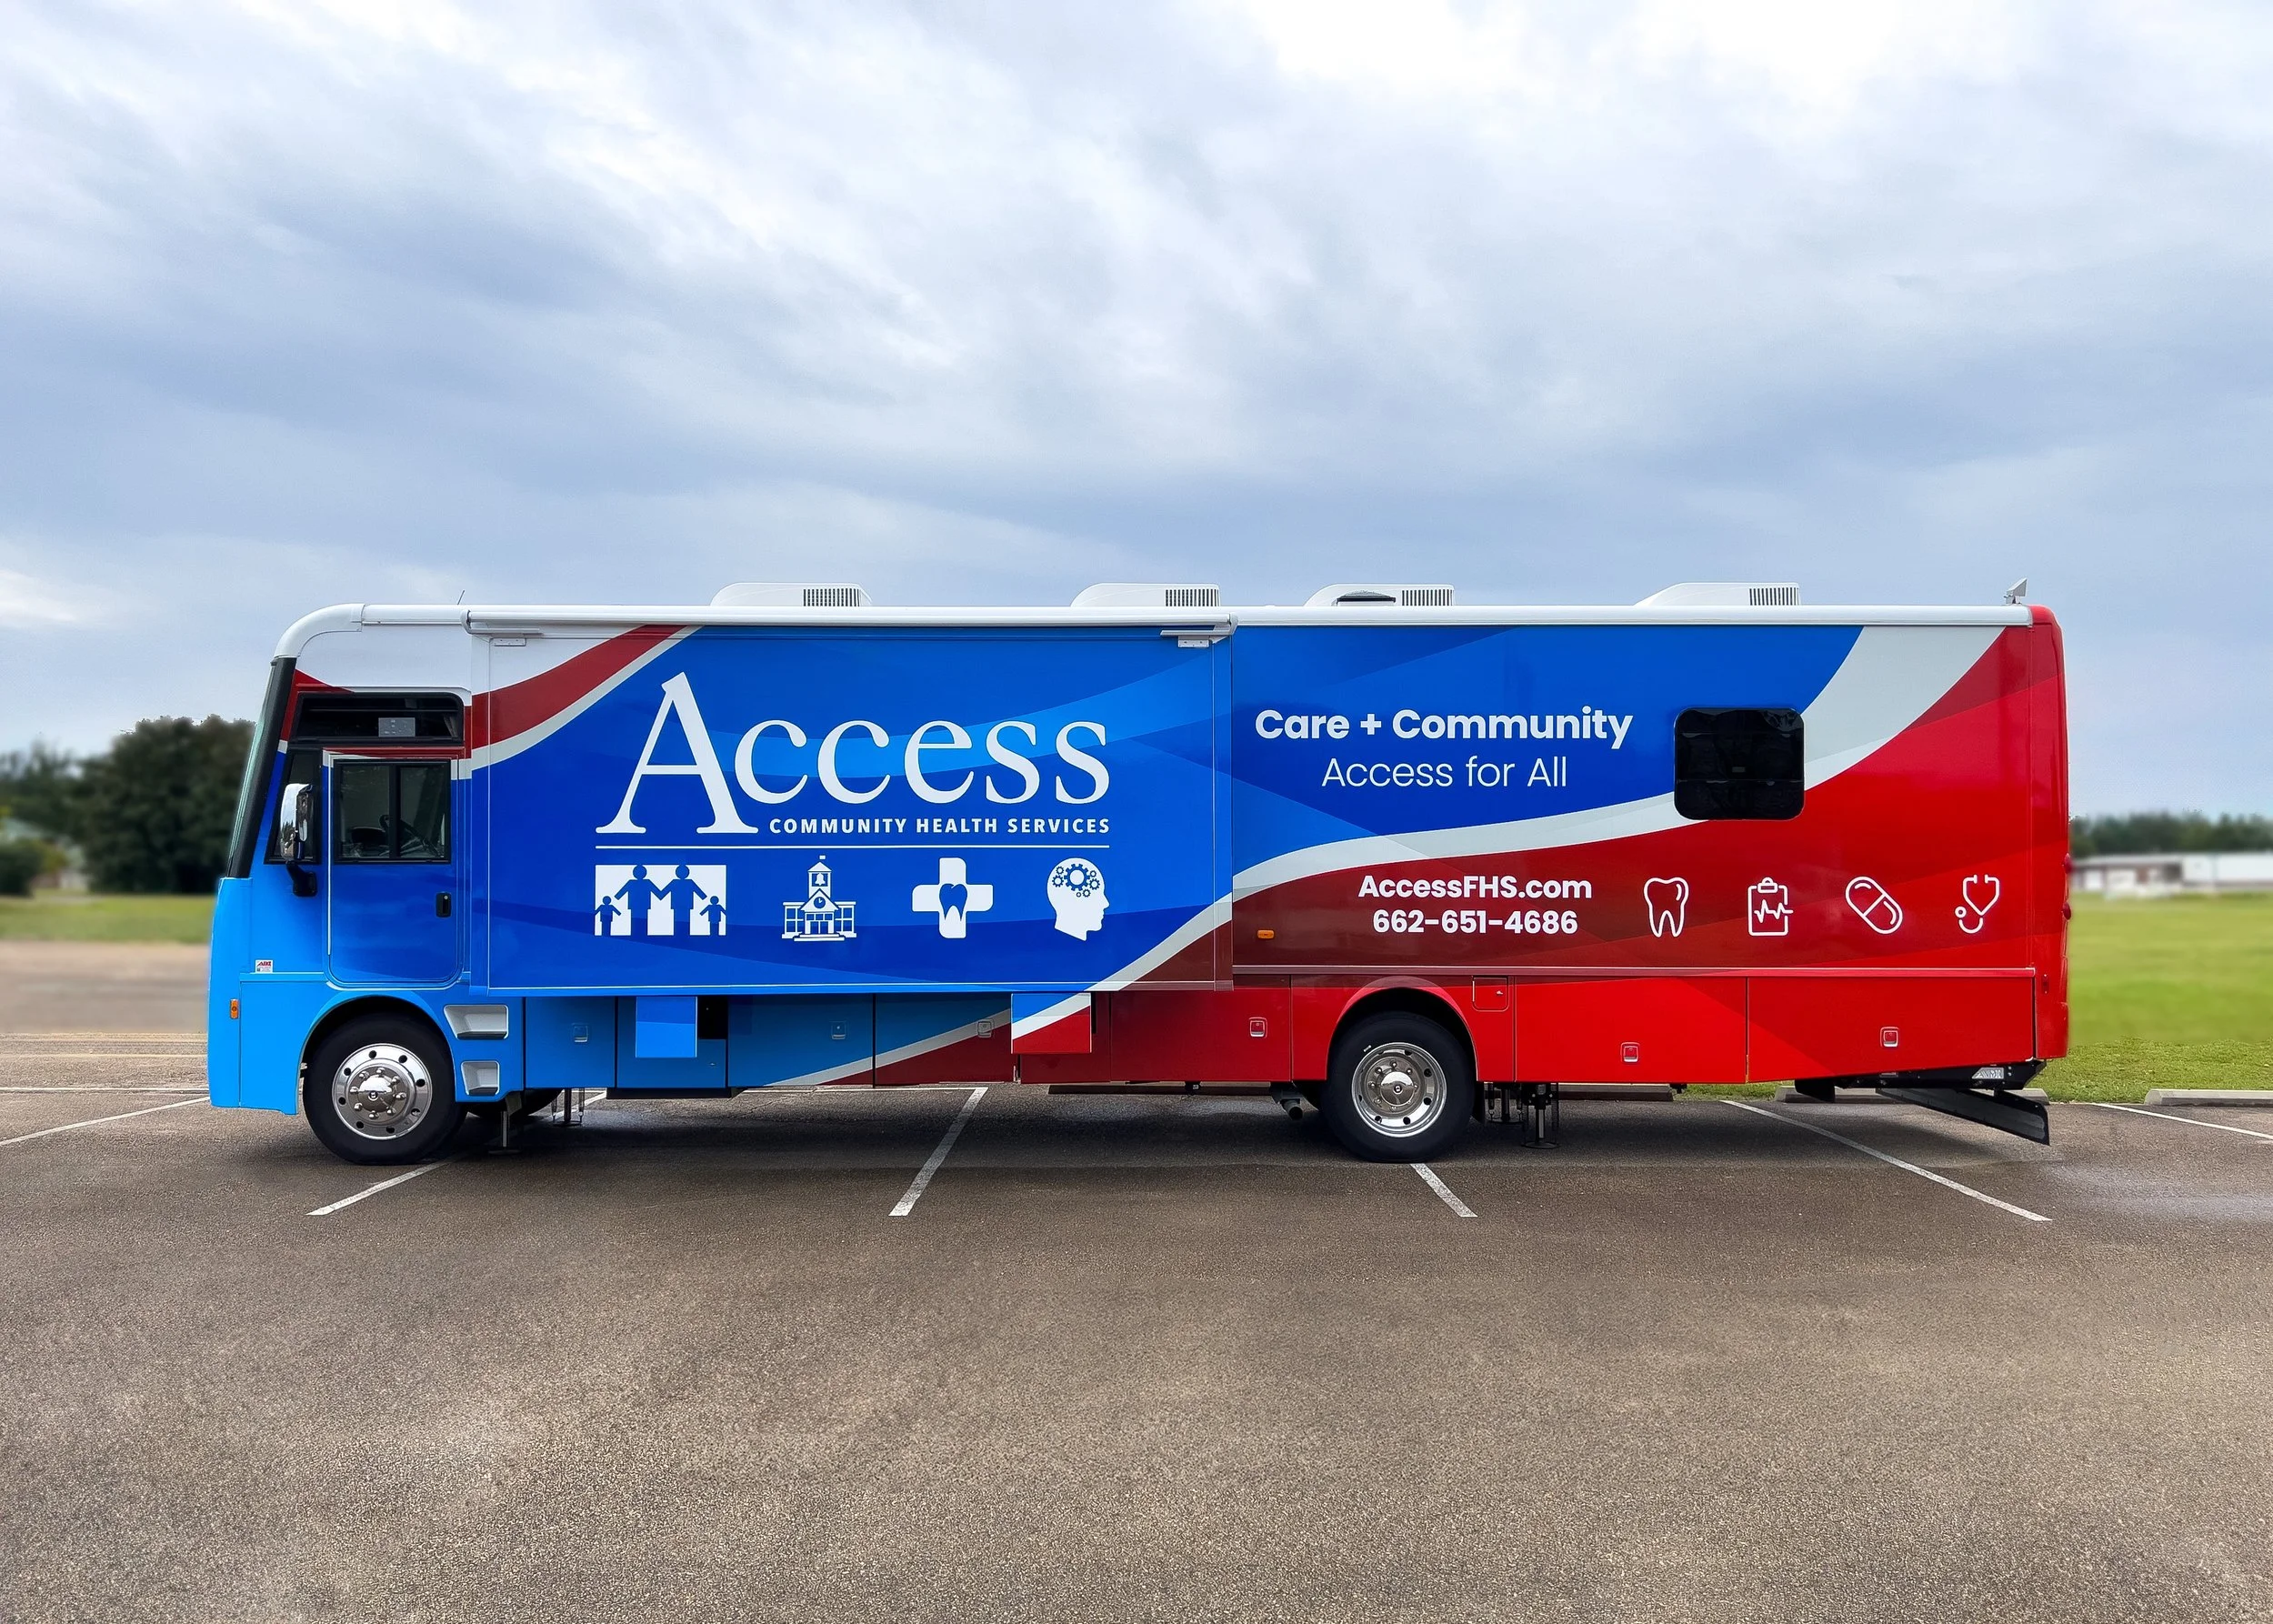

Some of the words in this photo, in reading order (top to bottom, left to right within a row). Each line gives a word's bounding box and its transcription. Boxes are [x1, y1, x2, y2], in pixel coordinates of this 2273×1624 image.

[1256, 709, 1350, 739] Care
[1361, 714, 1381, 735] +
[1393, 706, 1633, 749] Community
[595, 671, 1109, 834] Access
[1322, 758, 1453, 787] Access
[1466, 756, 1515, 787] for
[1527, 757, 1567, 787] All
[770, 817, 906, 834] COMMUNITY
[916, 817, 997, 833] HEALTH
[1007, 817, 1109, 834] SERVICES
[1358, 875, 1592, 899] AccessFHS.com
[1373, 909, 1578, 935] 662-651-4686
